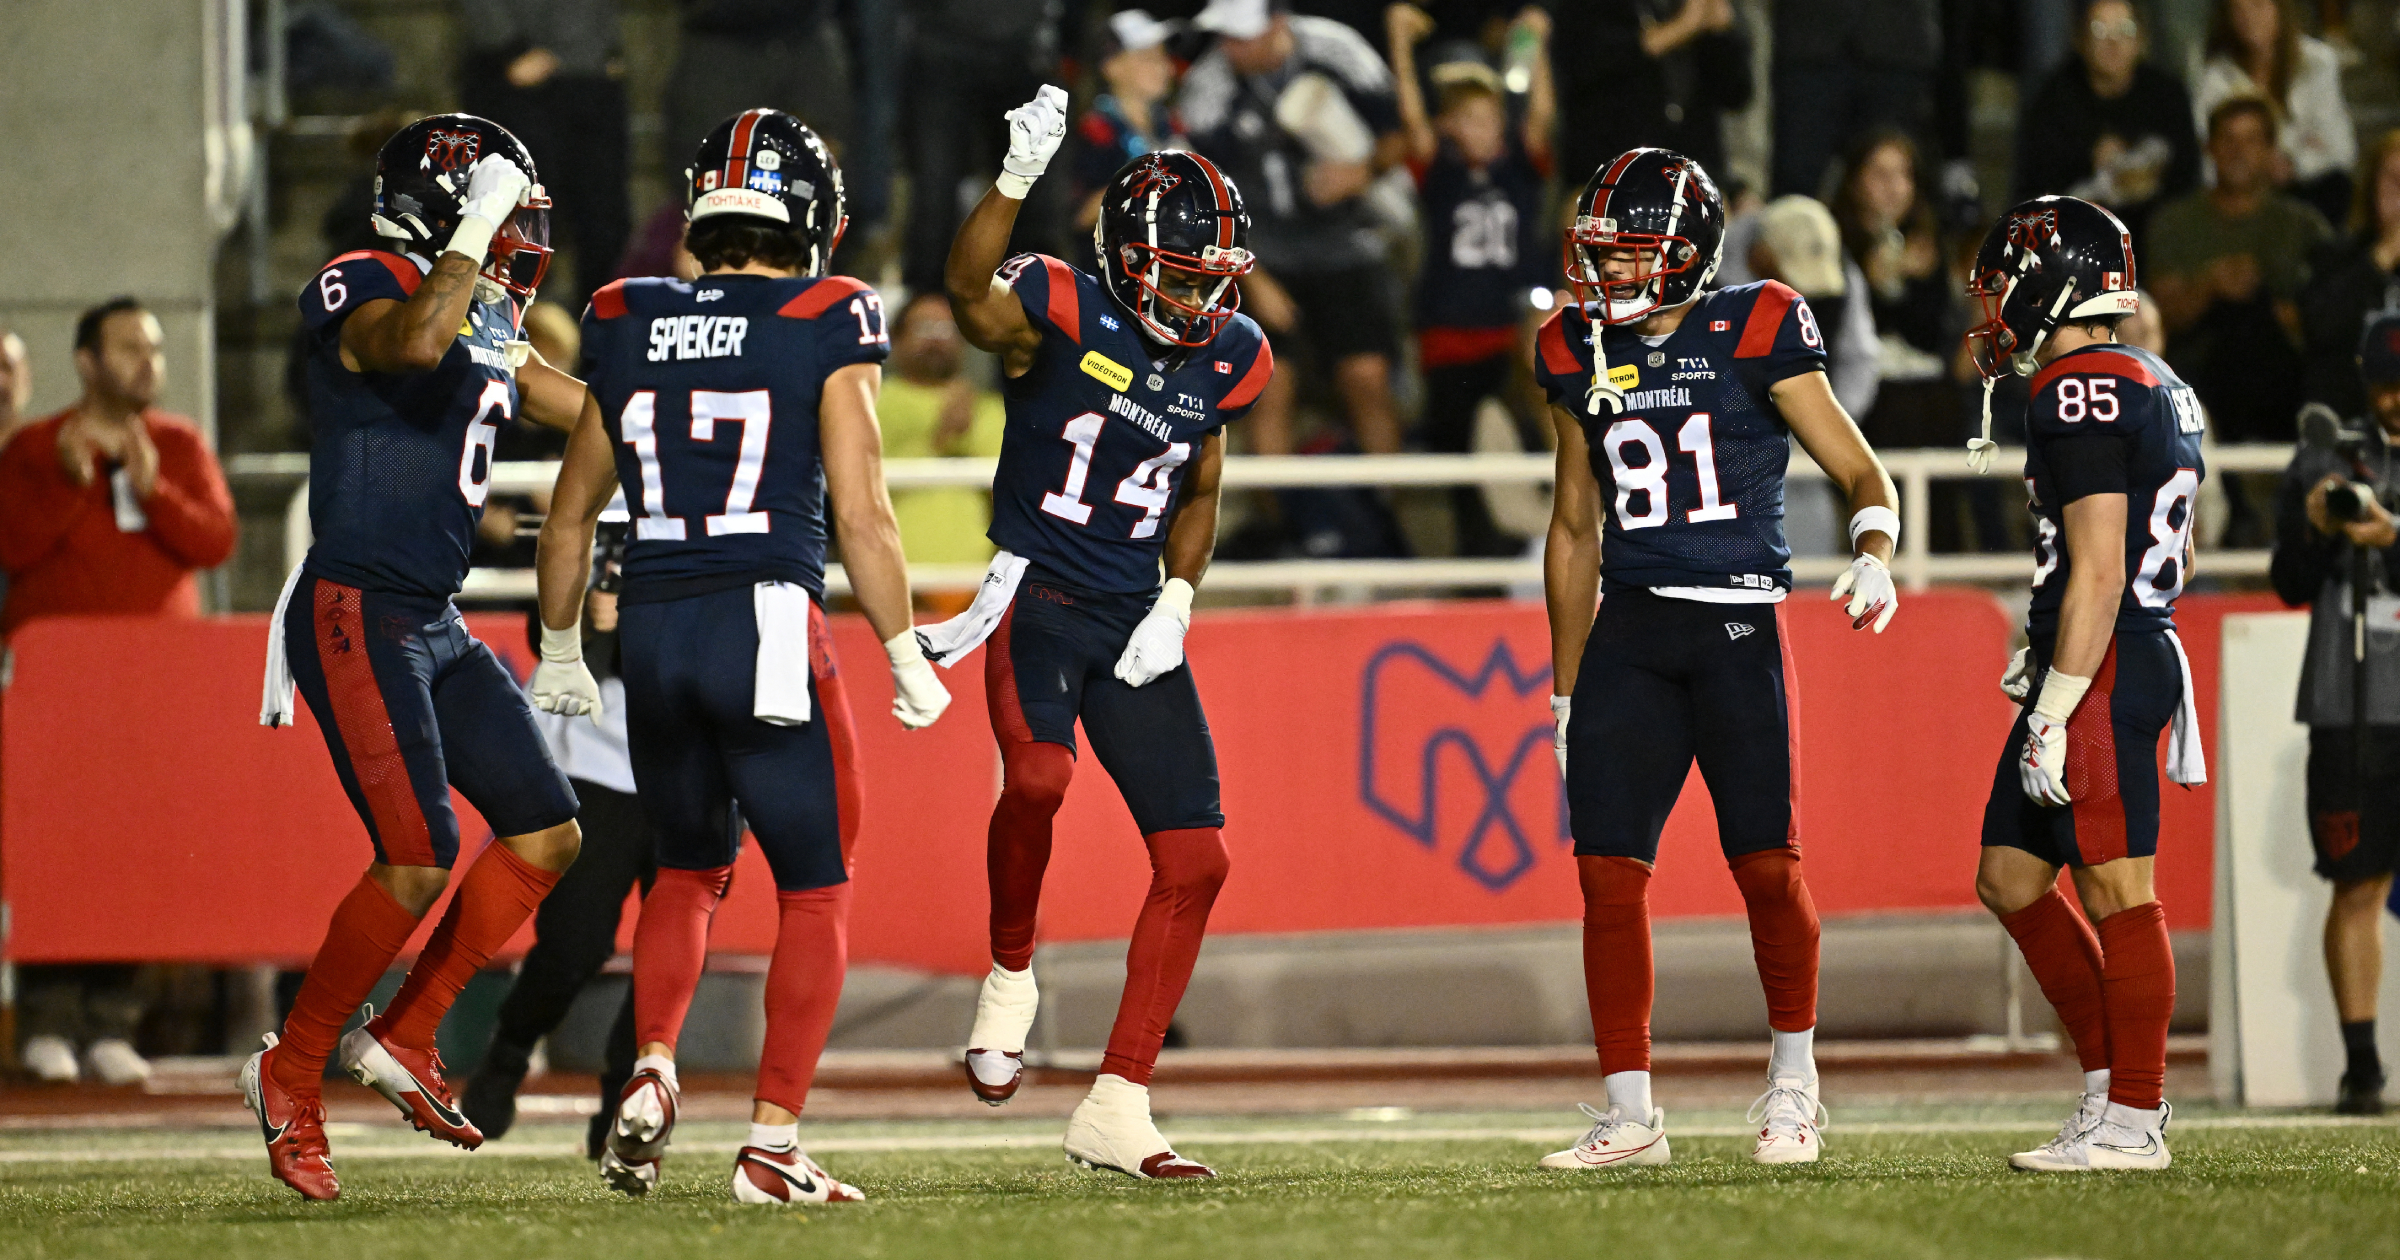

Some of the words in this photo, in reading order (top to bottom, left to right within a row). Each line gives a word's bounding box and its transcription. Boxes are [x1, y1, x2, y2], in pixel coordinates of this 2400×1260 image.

[319, 268, 347, 312] 6
[647, 315, 748, 362] SPIEKER
[850, 293, 889, 345] 17
[1086, 358, 1128, 384] VIDÉOTRON
[1609, 372, 1635, 384] OTRON
[1671, 371, 1716, 381] SPORTS
[1108, 392, 1173, 443] MONTRÉAL
[1166, 404, 1206, 421] SPORTS
[1624, 385, 1693, 412] MONTRÉAL
[2056, 377, 2120, 423] 85
[458, 379, 512, 507] 6
[620, 389, 772, 542] 17
[1040, 411, 1191, 539] 14
[1602, 412, 1738, 531] 81
[1761, 578, 1772, 588] 42
